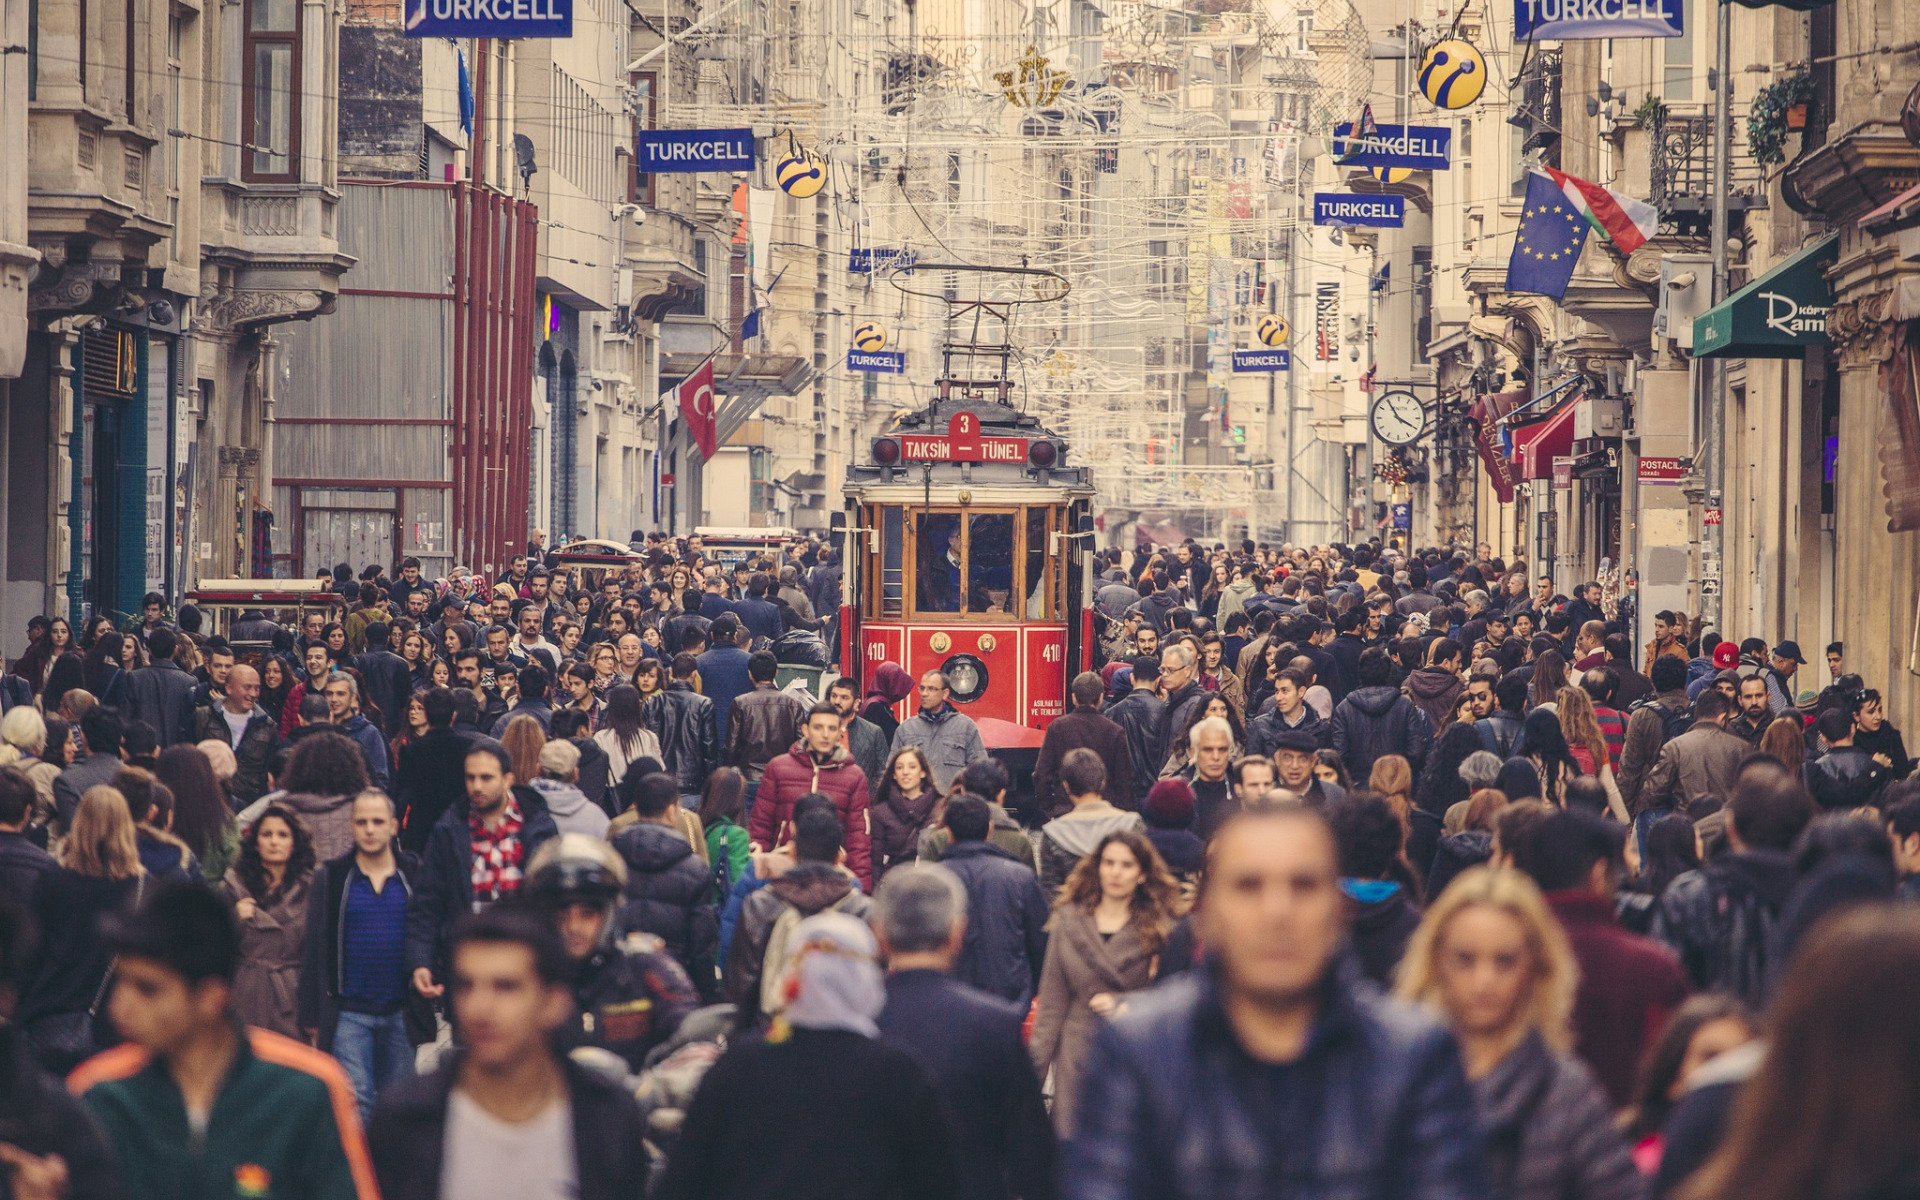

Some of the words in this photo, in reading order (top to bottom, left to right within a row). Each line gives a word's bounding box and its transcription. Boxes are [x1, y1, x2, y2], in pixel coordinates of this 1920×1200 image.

[1522, 0, 1673, 21] TURKCELL
[646, 141, 749, 161] TURKCELL
[1319, 202, 1400, 218] TURKCELL
[1758, 291, 1825, 337] Ram
[1798, 304, 1828, 315] KÖFT
[850, 355, 902, 368] TURKCELL
[1235, 356, 1287, 367] TURKCELL
[960, 415, 969, 433] 3
[905, 440, 950, 459] TAKSİM
[980, 441, 1023, 460] TÜNEL
[1640, 461, 1686, 470] POSTACIL
[867, 642, 885, 661] 410
[1042, 643, 1061, 663] 410
